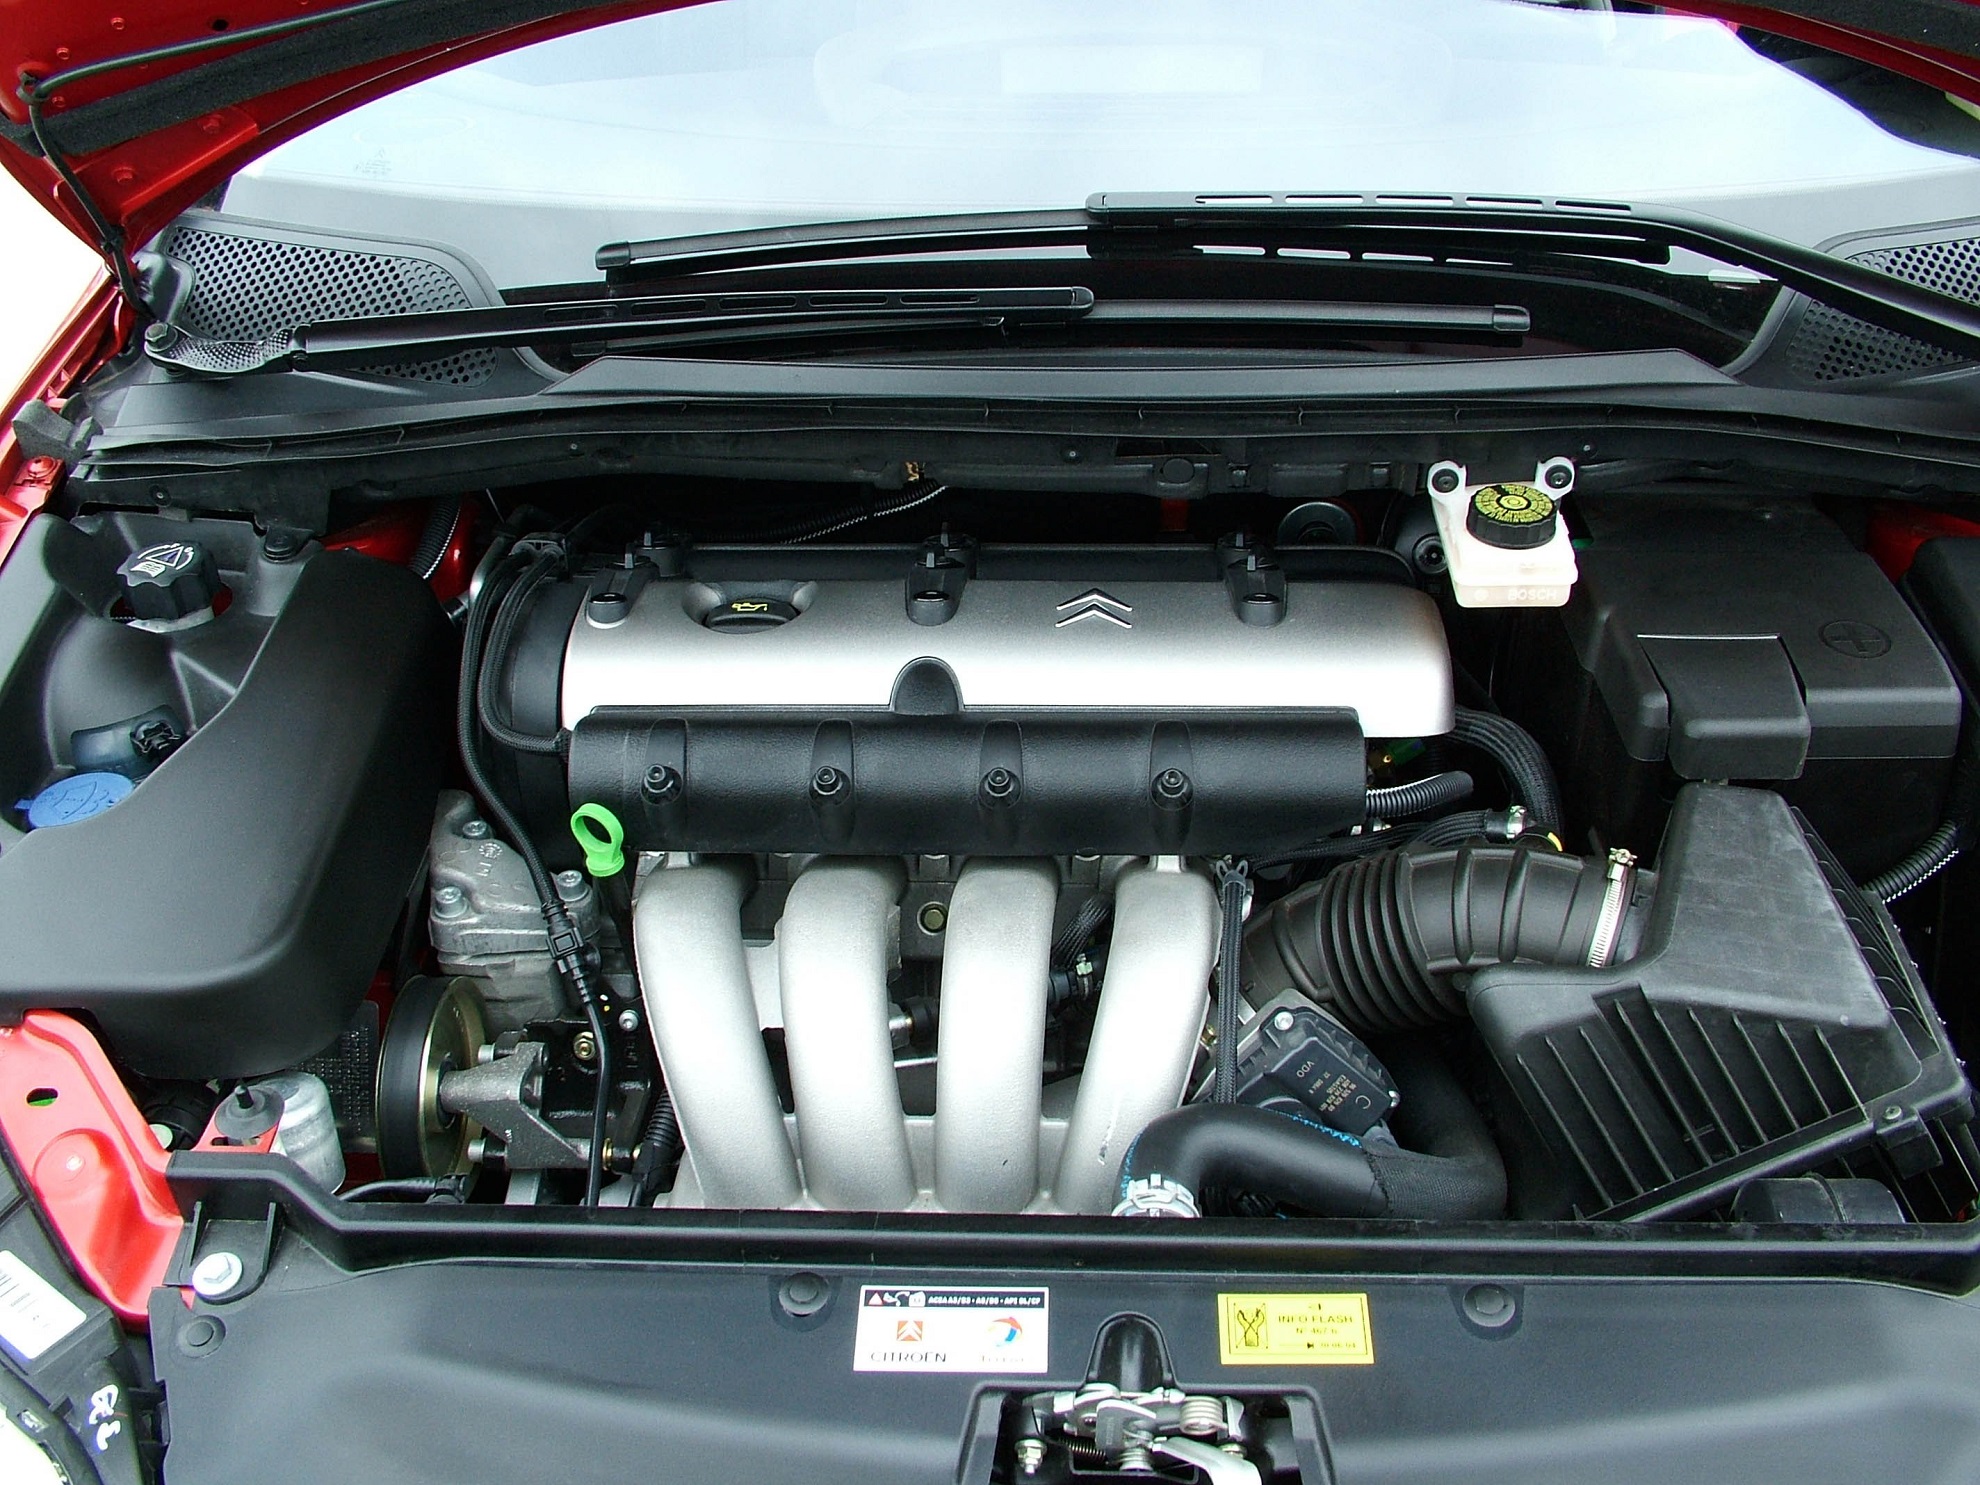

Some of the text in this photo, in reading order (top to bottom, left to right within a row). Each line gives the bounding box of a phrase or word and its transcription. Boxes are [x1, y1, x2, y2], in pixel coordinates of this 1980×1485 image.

[1507, 588, 1557, 601] BOSCH
[1296, 1061, 1315, 1078] VDO
[1278, 1315, 1353, 1323] INFO FLASH
